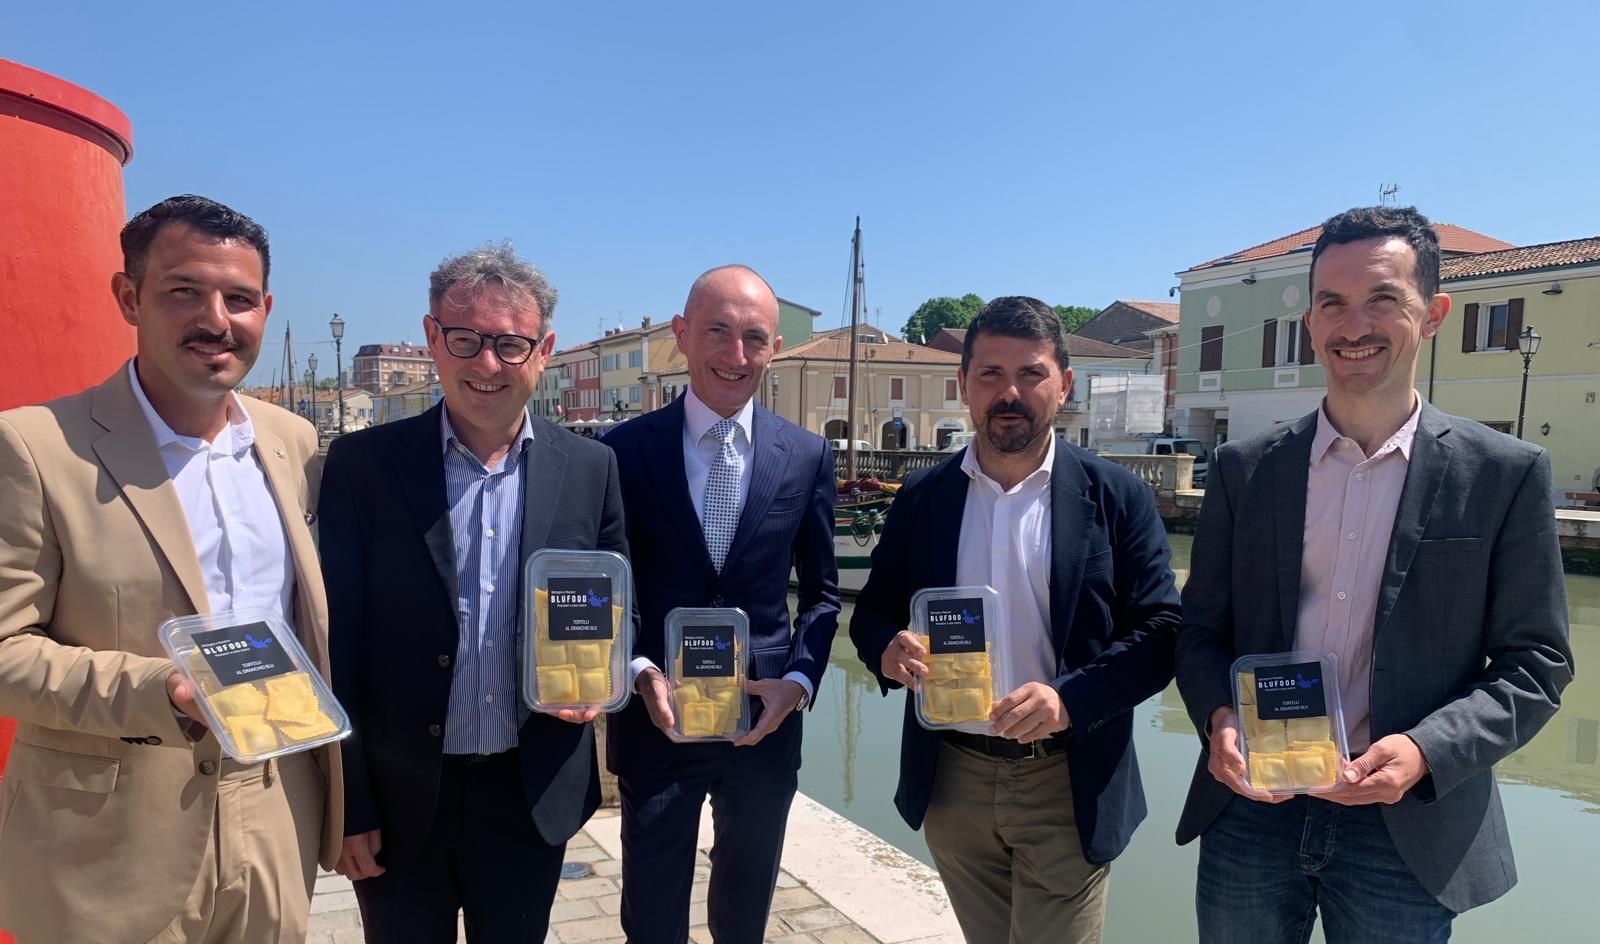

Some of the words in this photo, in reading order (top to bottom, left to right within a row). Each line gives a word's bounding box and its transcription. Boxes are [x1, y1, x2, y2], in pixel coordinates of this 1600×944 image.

[551, 595, 587, 603] BLUFOOD
[930, 614, 962, 622] BLUFOOD
[203, 641, 248, 655] BLUFOOD
[1258, 680, 1296, 688] BLUFOOD
